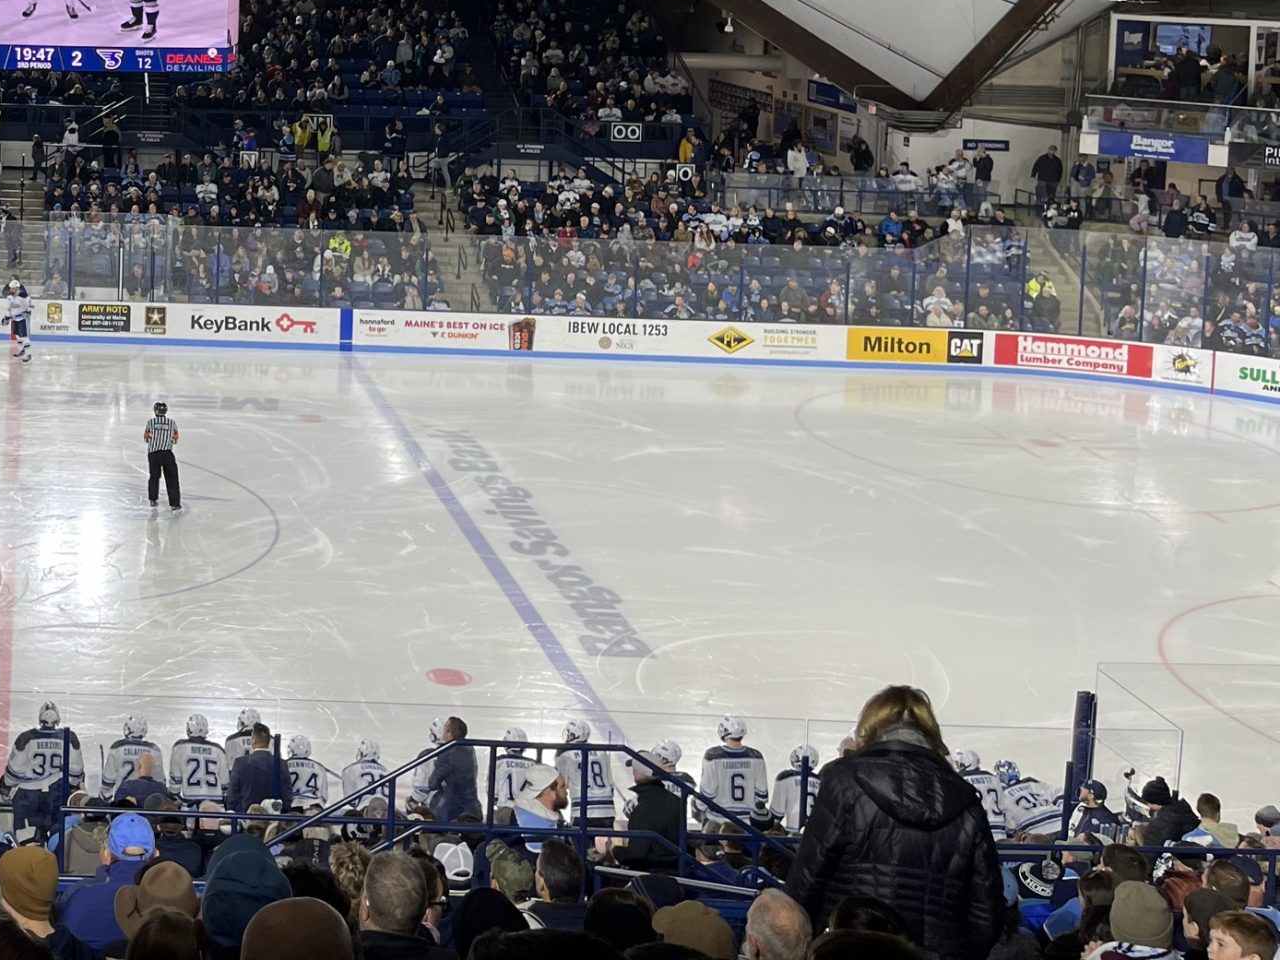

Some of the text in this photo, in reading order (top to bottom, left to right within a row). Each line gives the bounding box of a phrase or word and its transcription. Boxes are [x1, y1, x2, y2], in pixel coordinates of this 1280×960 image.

[15, 47, 55, 61] 19:47
[71, 51, 83, 67] 2
[137, 57, 152, 69] 12
[166, 63, 223, 72] DETAILING
[614, 125, 640, 139] OO
[1132, 135, 1175, 148] Bangor
[243, 154, 256, 169] N
[81, 304, 128, 314] ARMY ROTC
[190, 314, 272, 333] KeyBank
[359, 318, 395, 326] hannaford
[404, 319, 505, 332] MAINE'S BEST ON ICE
[568, 321, 668, 337] IBEW LOCAL 1253
[763, 335, 818, 345] TOGETHER
[863, 336, 931, 354] Milton
[950, 337, 981, 356] CAT
[1018, 336, 1129, 360] Hammond
[1020, 354, 1124, 373] Lumber Company
[191, 745, 213, 756] NIEMO
[186, 757, 218, 788] 25
[289, 771, 319, 796] 24
[730, 773, 745, 802] 6
